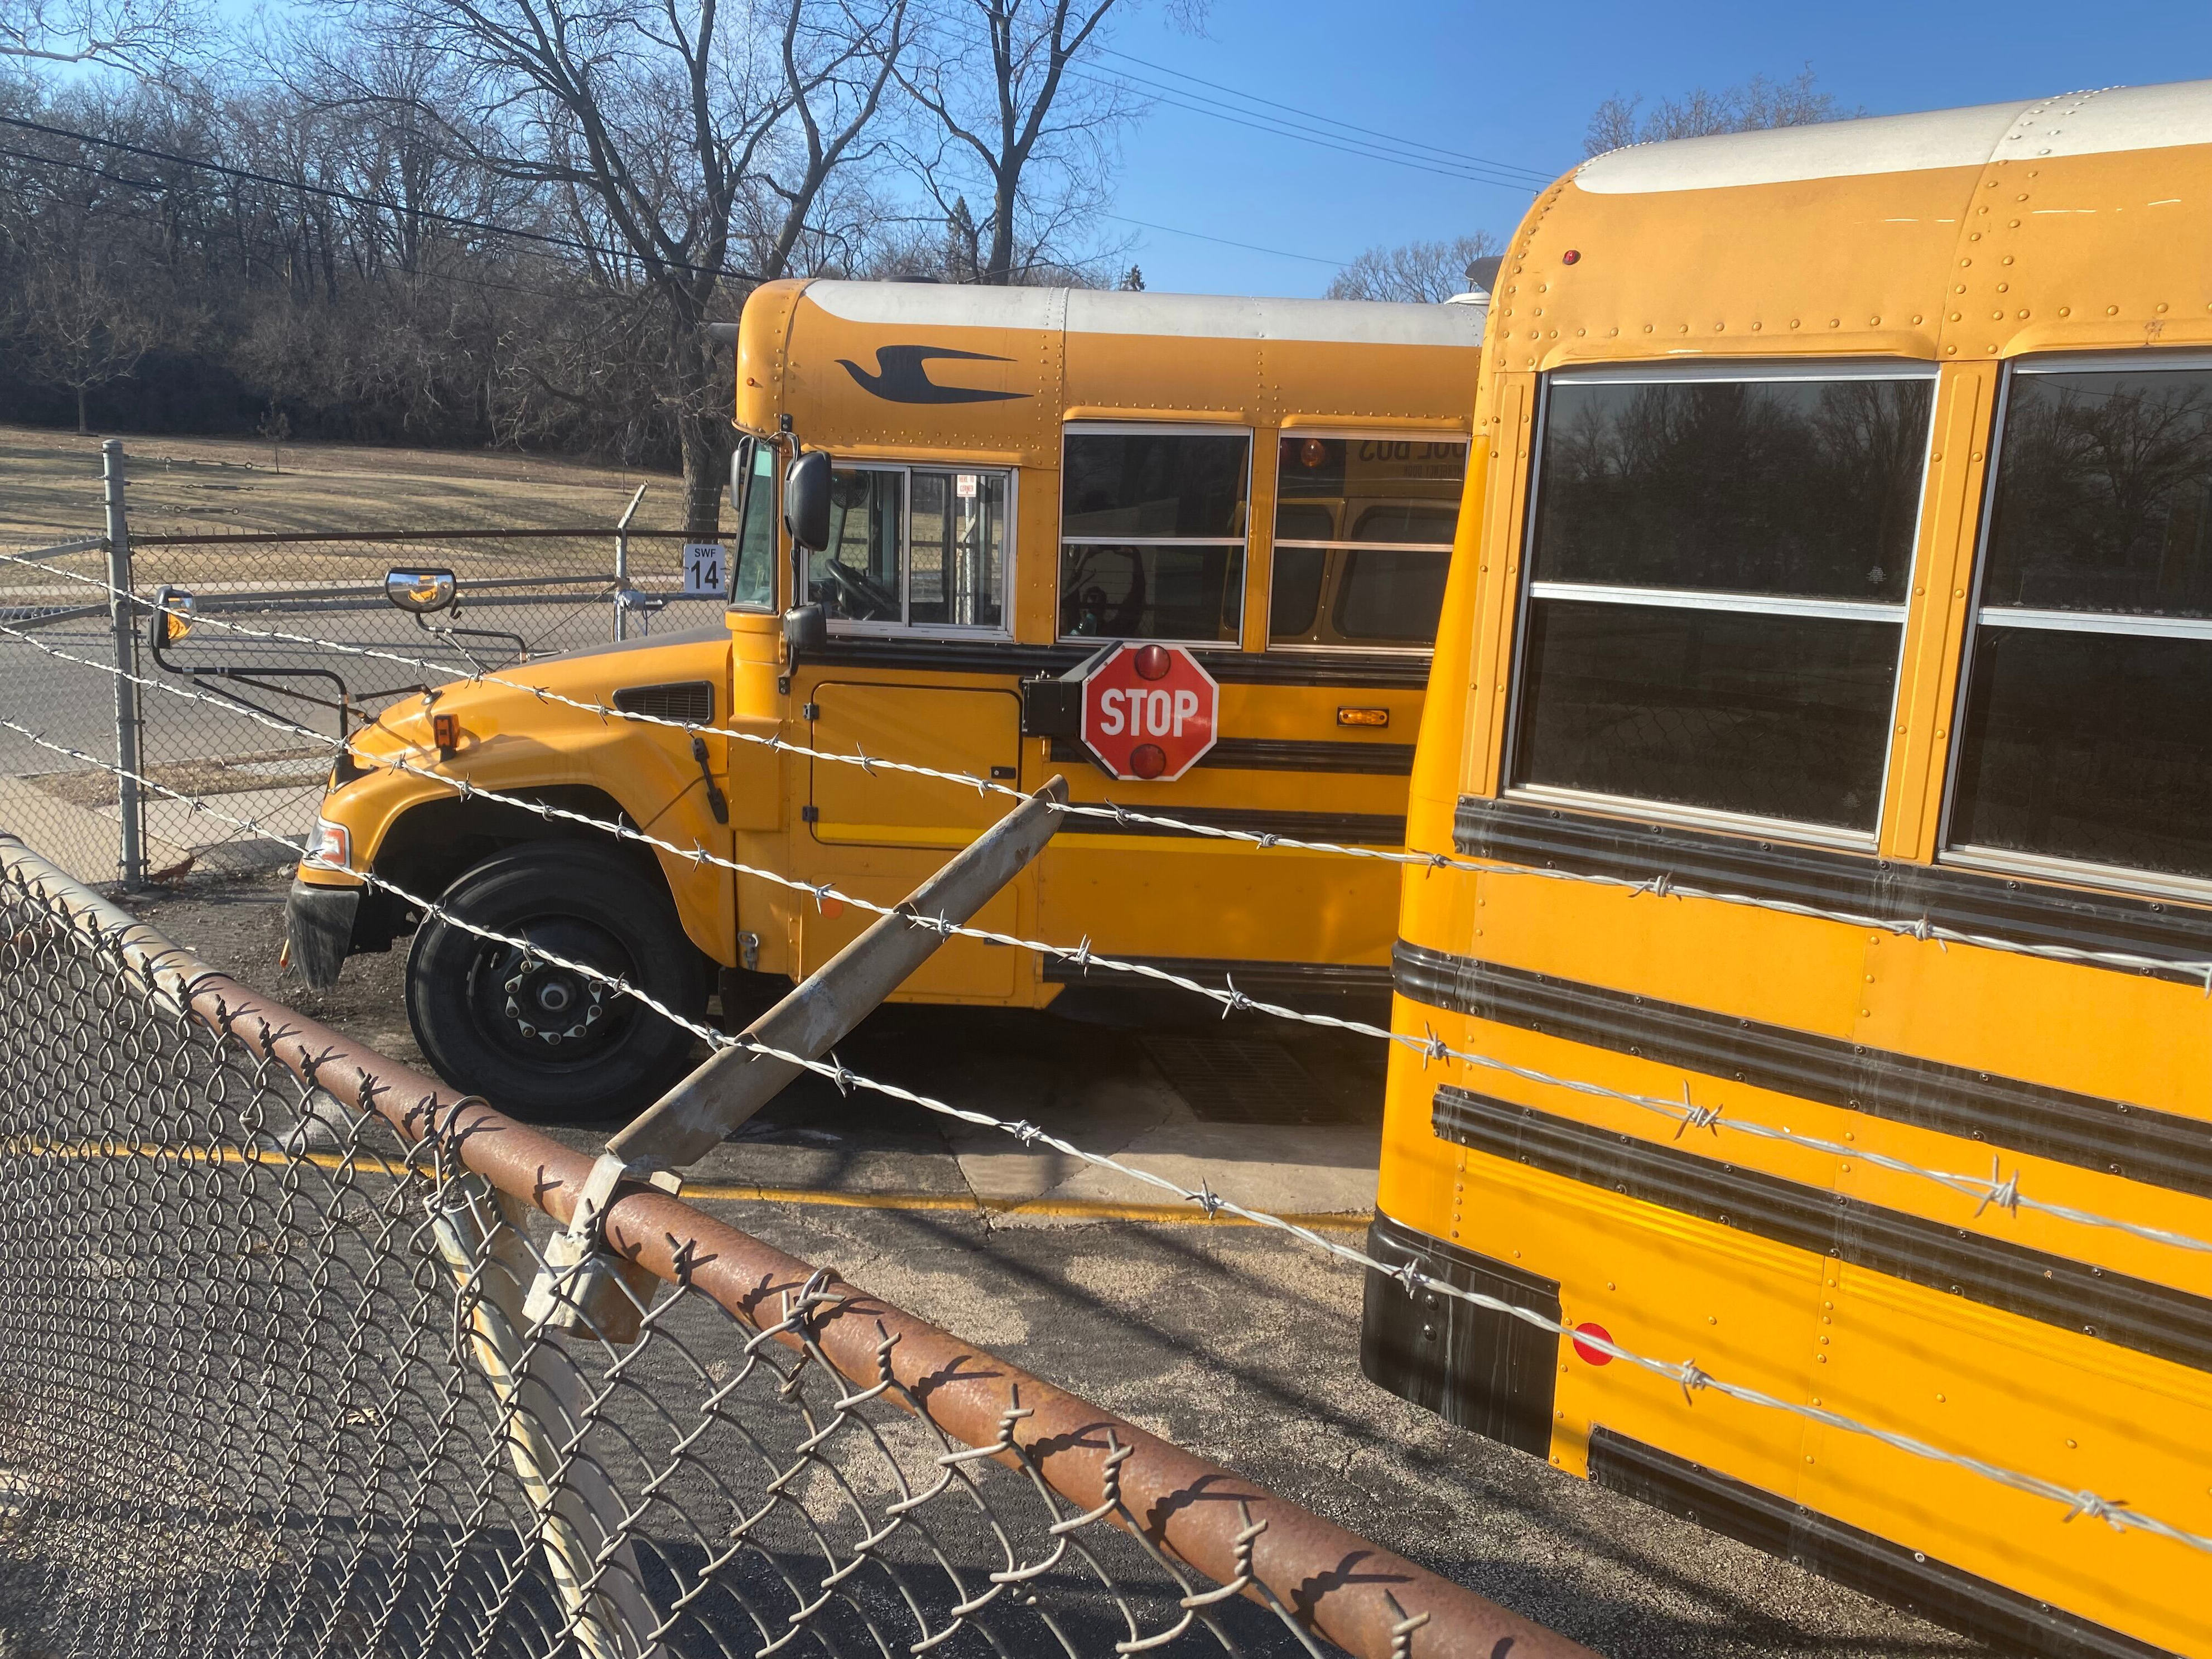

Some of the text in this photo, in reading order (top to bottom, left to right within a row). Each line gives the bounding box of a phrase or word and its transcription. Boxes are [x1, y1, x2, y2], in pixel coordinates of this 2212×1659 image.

[695, 548, 716, 557] SWF
[691, 560, 719, 589] 14
[1100, 688, 1198, 737] STOP
